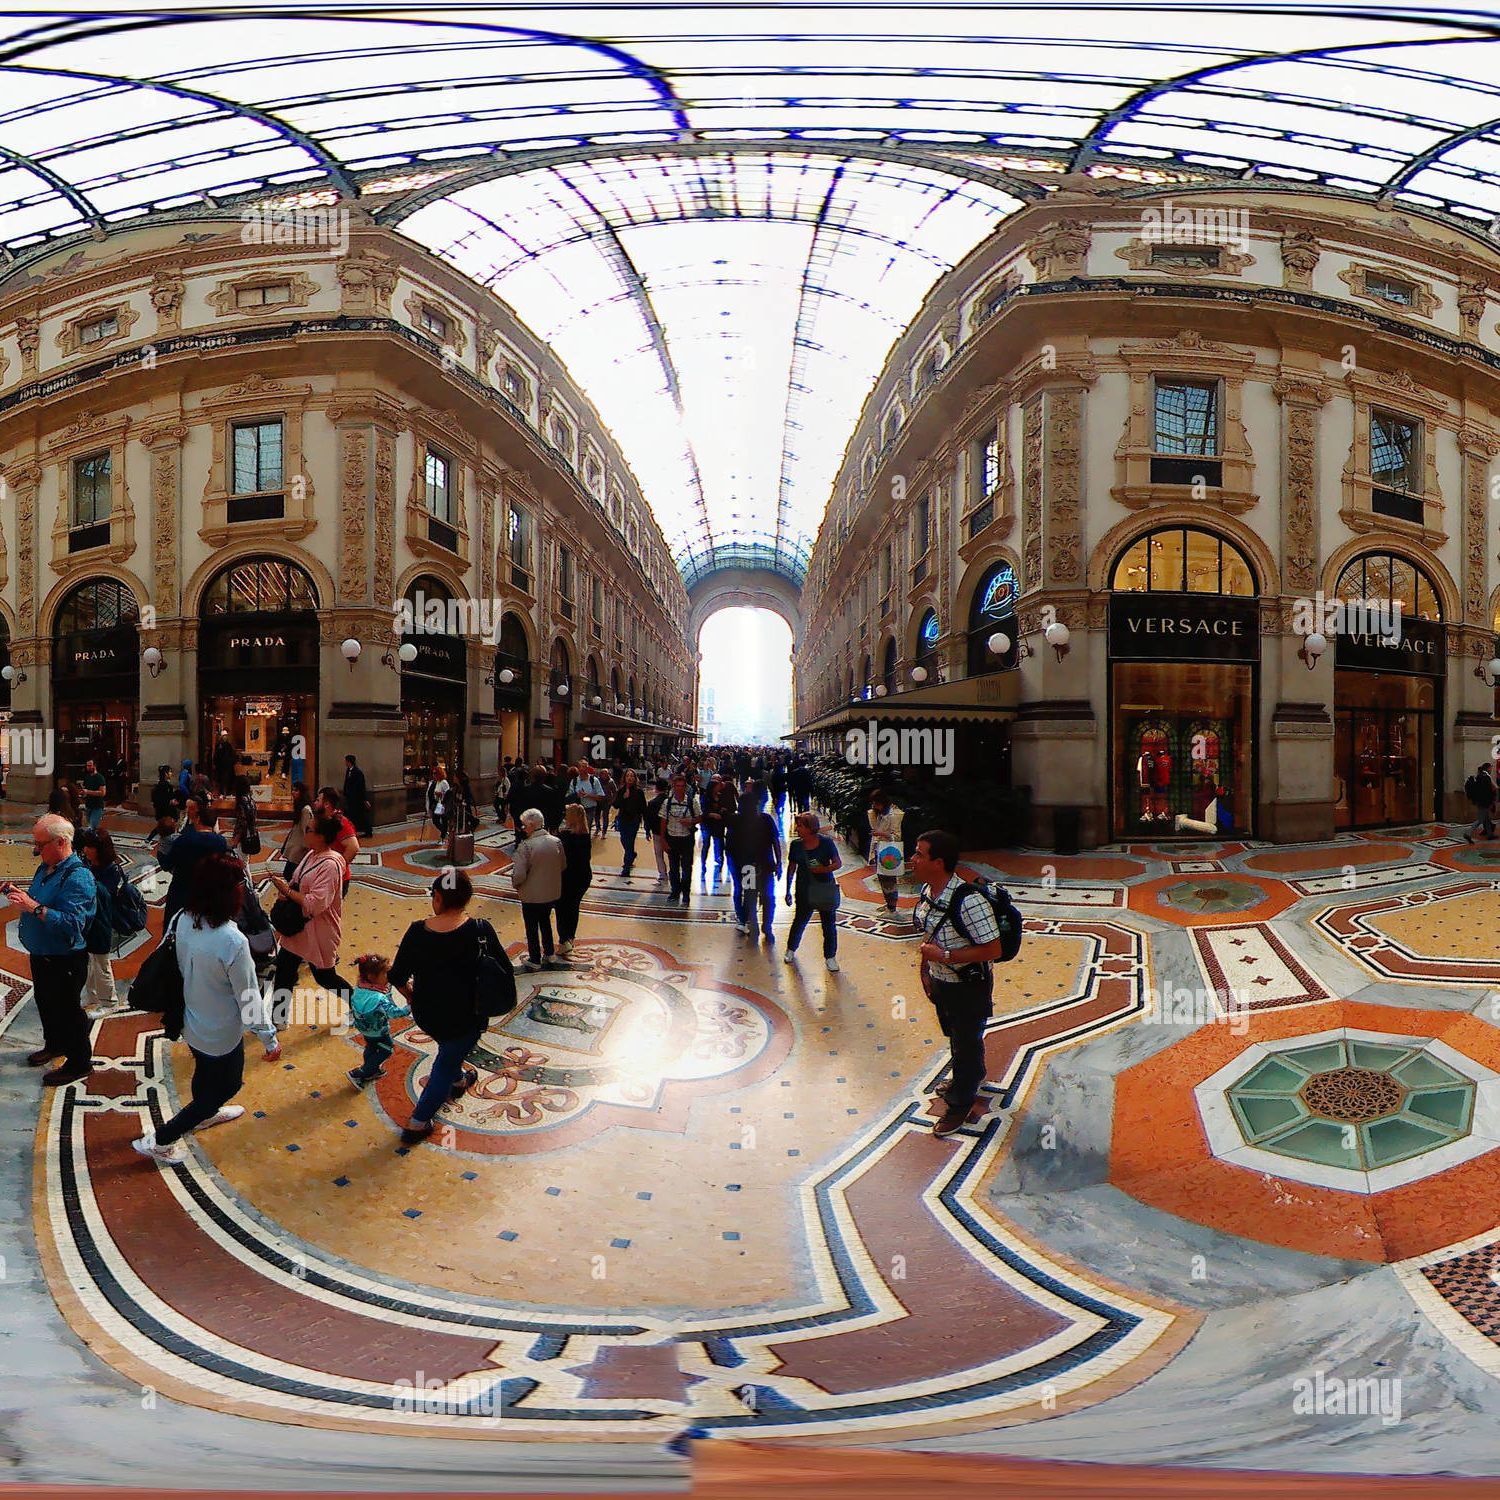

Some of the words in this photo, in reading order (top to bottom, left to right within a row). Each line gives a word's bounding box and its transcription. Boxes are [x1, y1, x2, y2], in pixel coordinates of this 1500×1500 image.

[1127, 617, 1243, 636] VERSACE
[230, 636, 286, 648] PRADA
[1350, 631, 1437, 655] VERSACE
[75, 649, 115, 661] PRADA
[418, 645, 451, 660] PRADA
